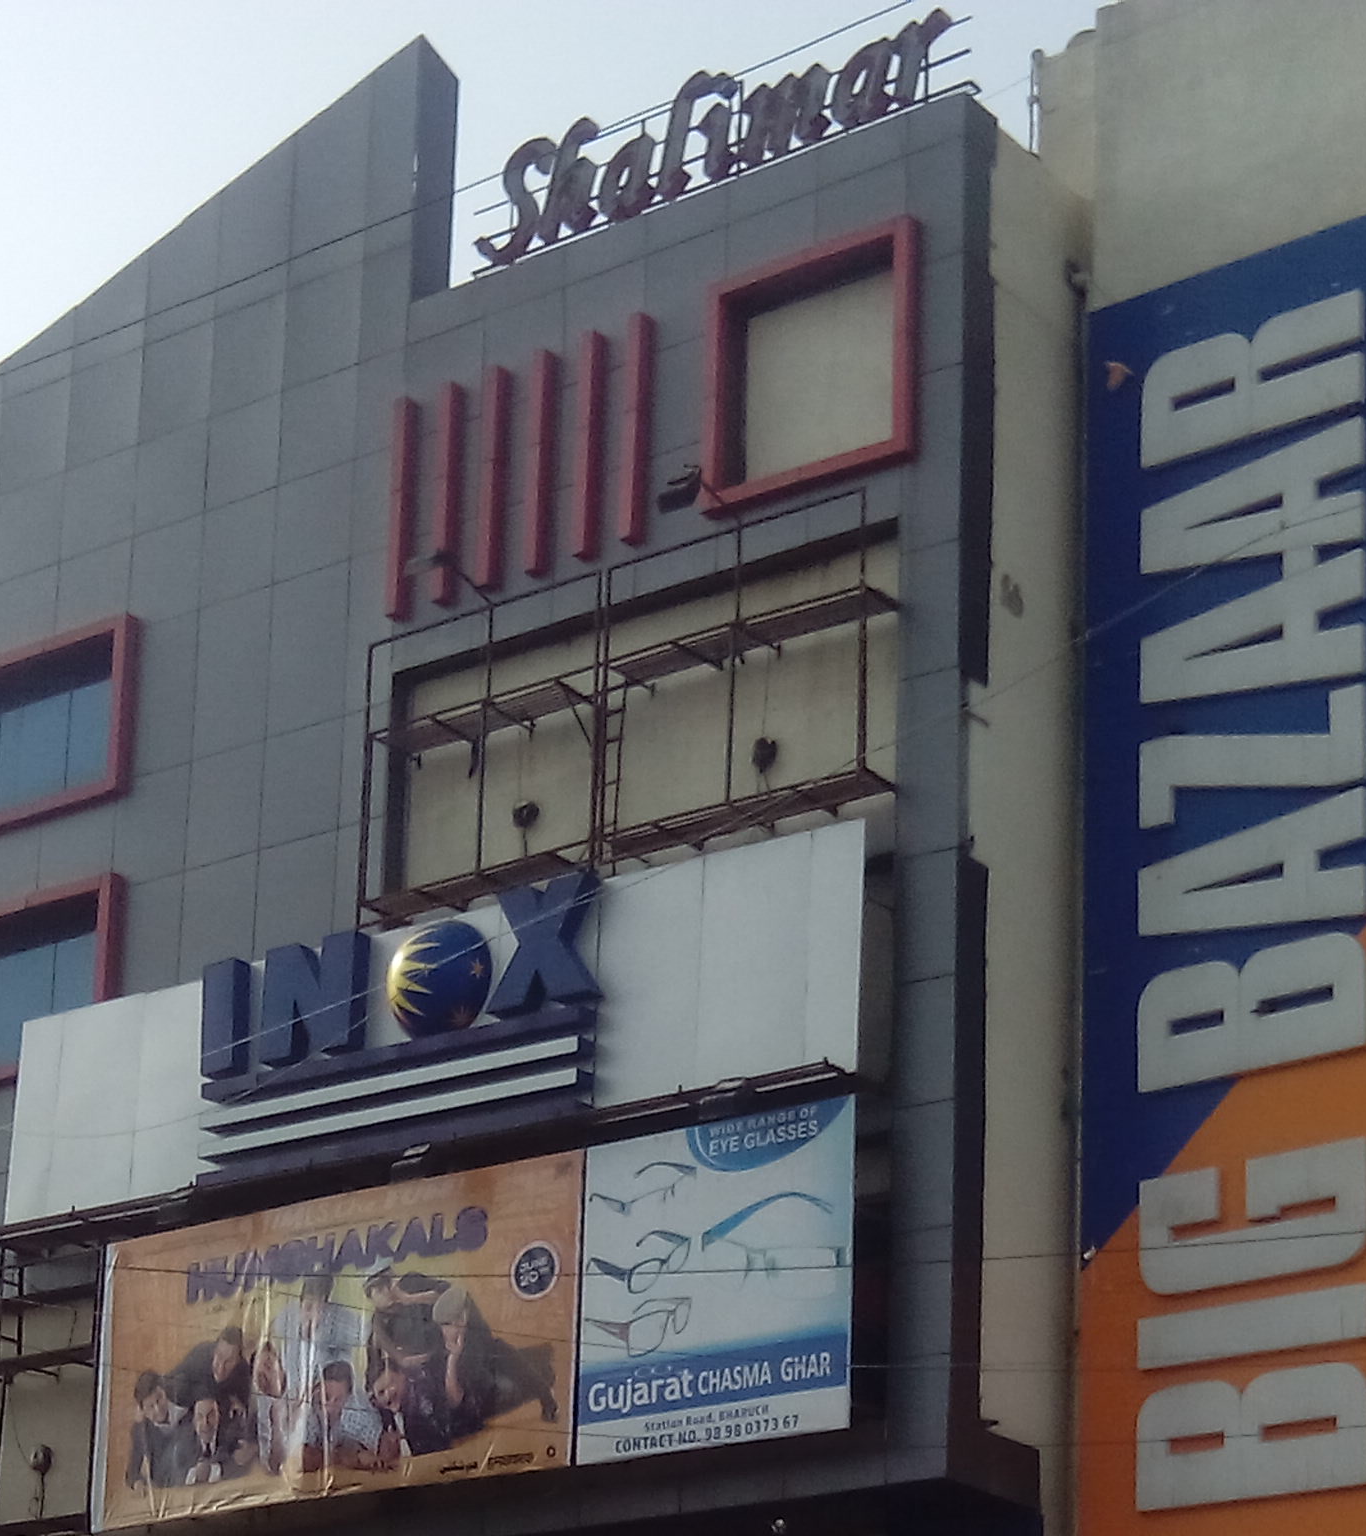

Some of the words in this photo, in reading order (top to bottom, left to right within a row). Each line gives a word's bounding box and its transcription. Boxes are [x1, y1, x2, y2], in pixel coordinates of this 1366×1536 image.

[475, 8, 952, 266] Shalimar
[201, 871, 605, 1078] INOX
[799, 1105, 819, 1119] OF
[708, 1134, 739, 1157] EYE
[743, 1120, 819, 1150] GLASSES
[587, 1367, 695, 1414] Gujarat
[697, 1361, 772, 1396] CHASMA
[780, 1352, 832, 1382] GHAR
[615, 1431, 675, 1454] CONTACT
